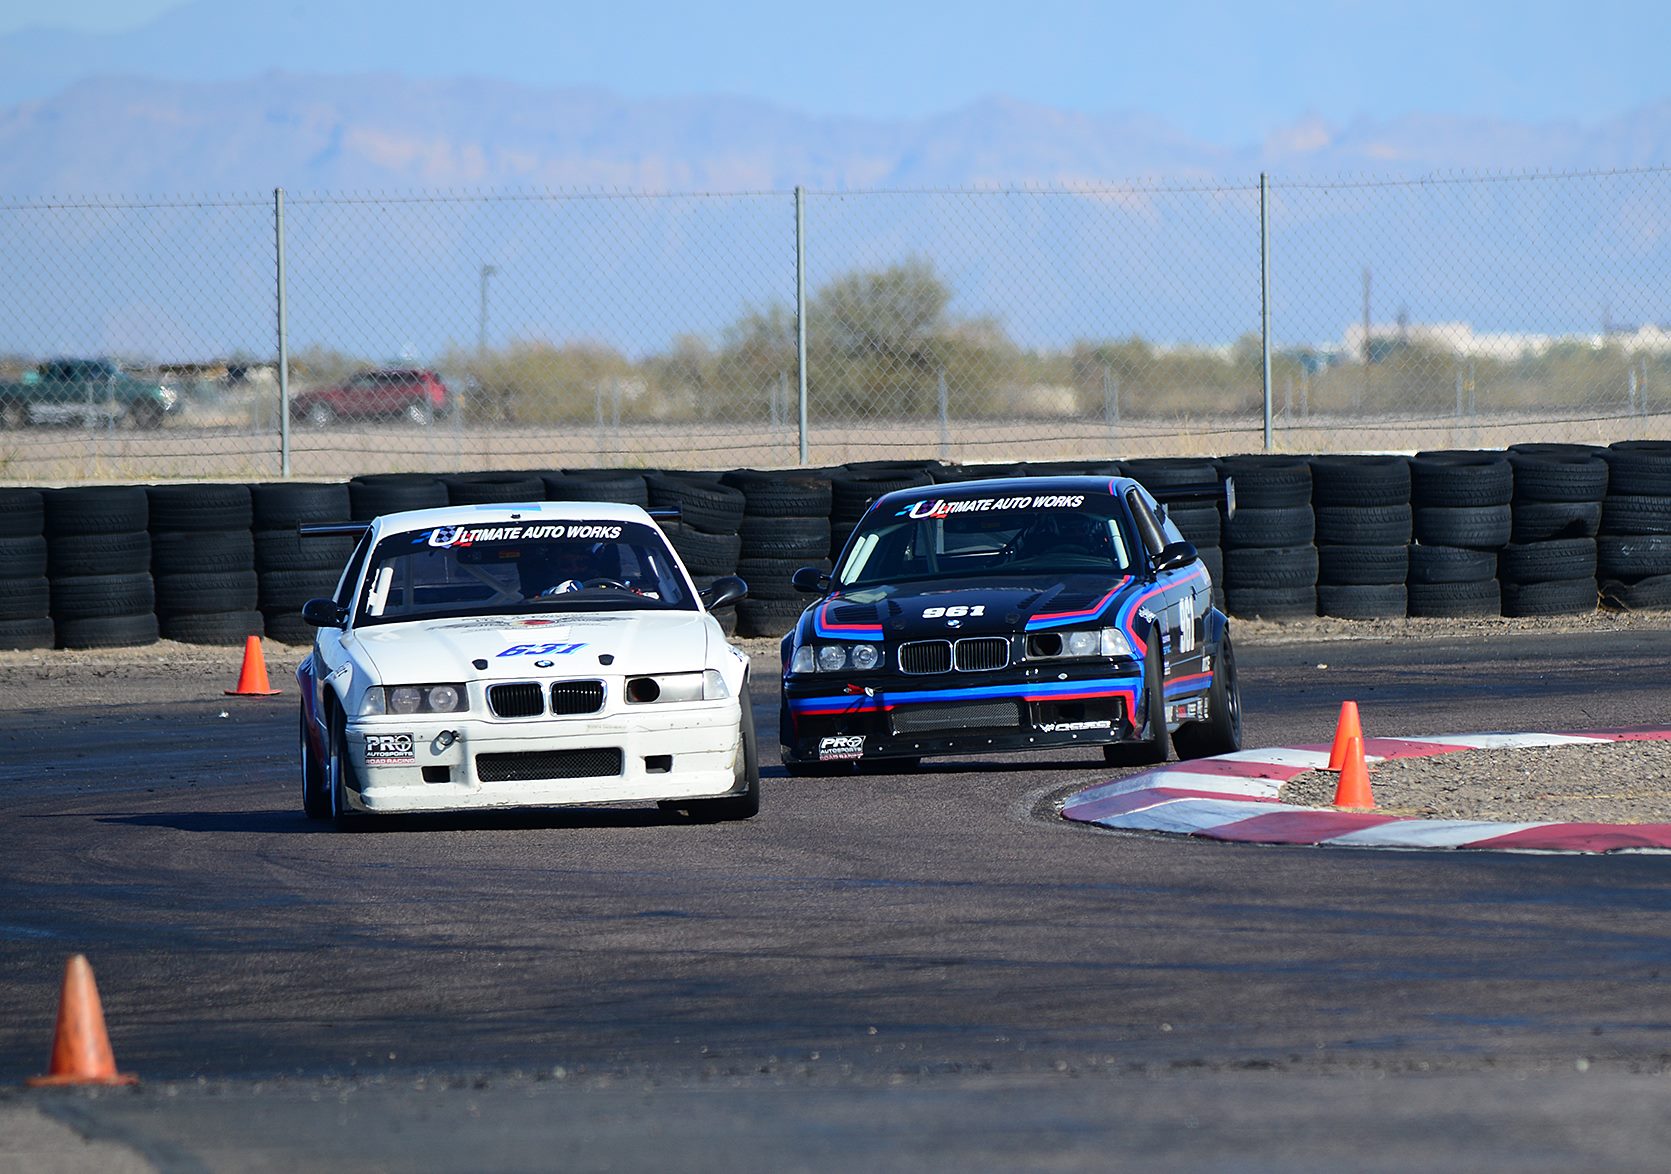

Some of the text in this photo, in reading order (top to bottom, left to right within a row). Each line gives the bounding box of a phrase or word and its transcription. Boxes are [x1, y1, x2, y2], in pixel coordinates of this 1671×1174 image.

[909, 495, 1085, 519] ULTIMATE AUTO WORKS
[428, 525, 623, 547] ULTIMATE AUTO WORKS
[922, 605, 986, 619] 961
[495, 642, 591, 658] 631
[366, 735, 412, 751] PRO
[821, 736, 863, 749] PRO
